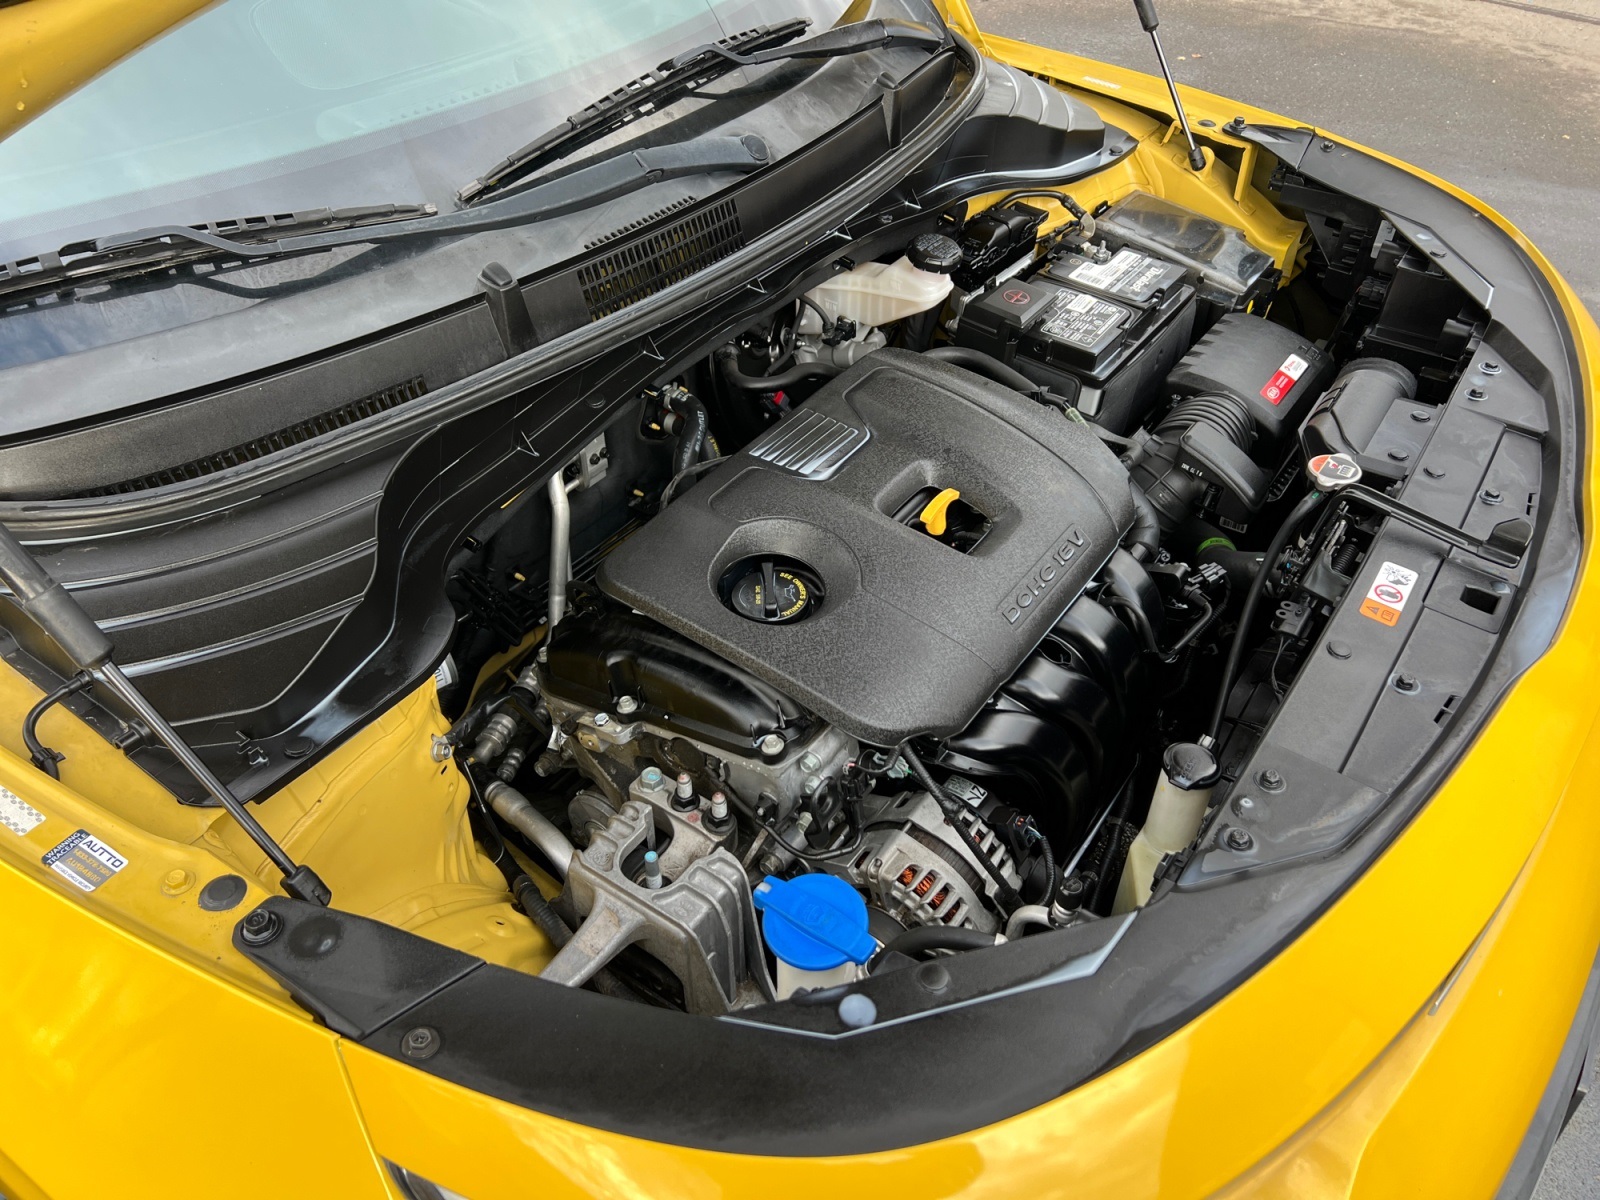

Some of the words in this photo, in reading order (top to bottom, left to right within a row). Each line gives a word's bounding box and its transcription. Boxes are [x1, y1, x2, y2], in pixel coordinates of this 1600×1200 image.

[1130, 267, 1163, 292] Duralast
[780, 572, 793, 580] SEE
[1002, 565, 1056, 625] DOHC
[1053, 530, 1085, 567] 16V
[780, 600, 804, 617] MANUAL
[45, 832, 81, 858] WARNING
[46, 833, 88, 865] TRACEABLE
[83, 840, 124, 868] AUTTO
